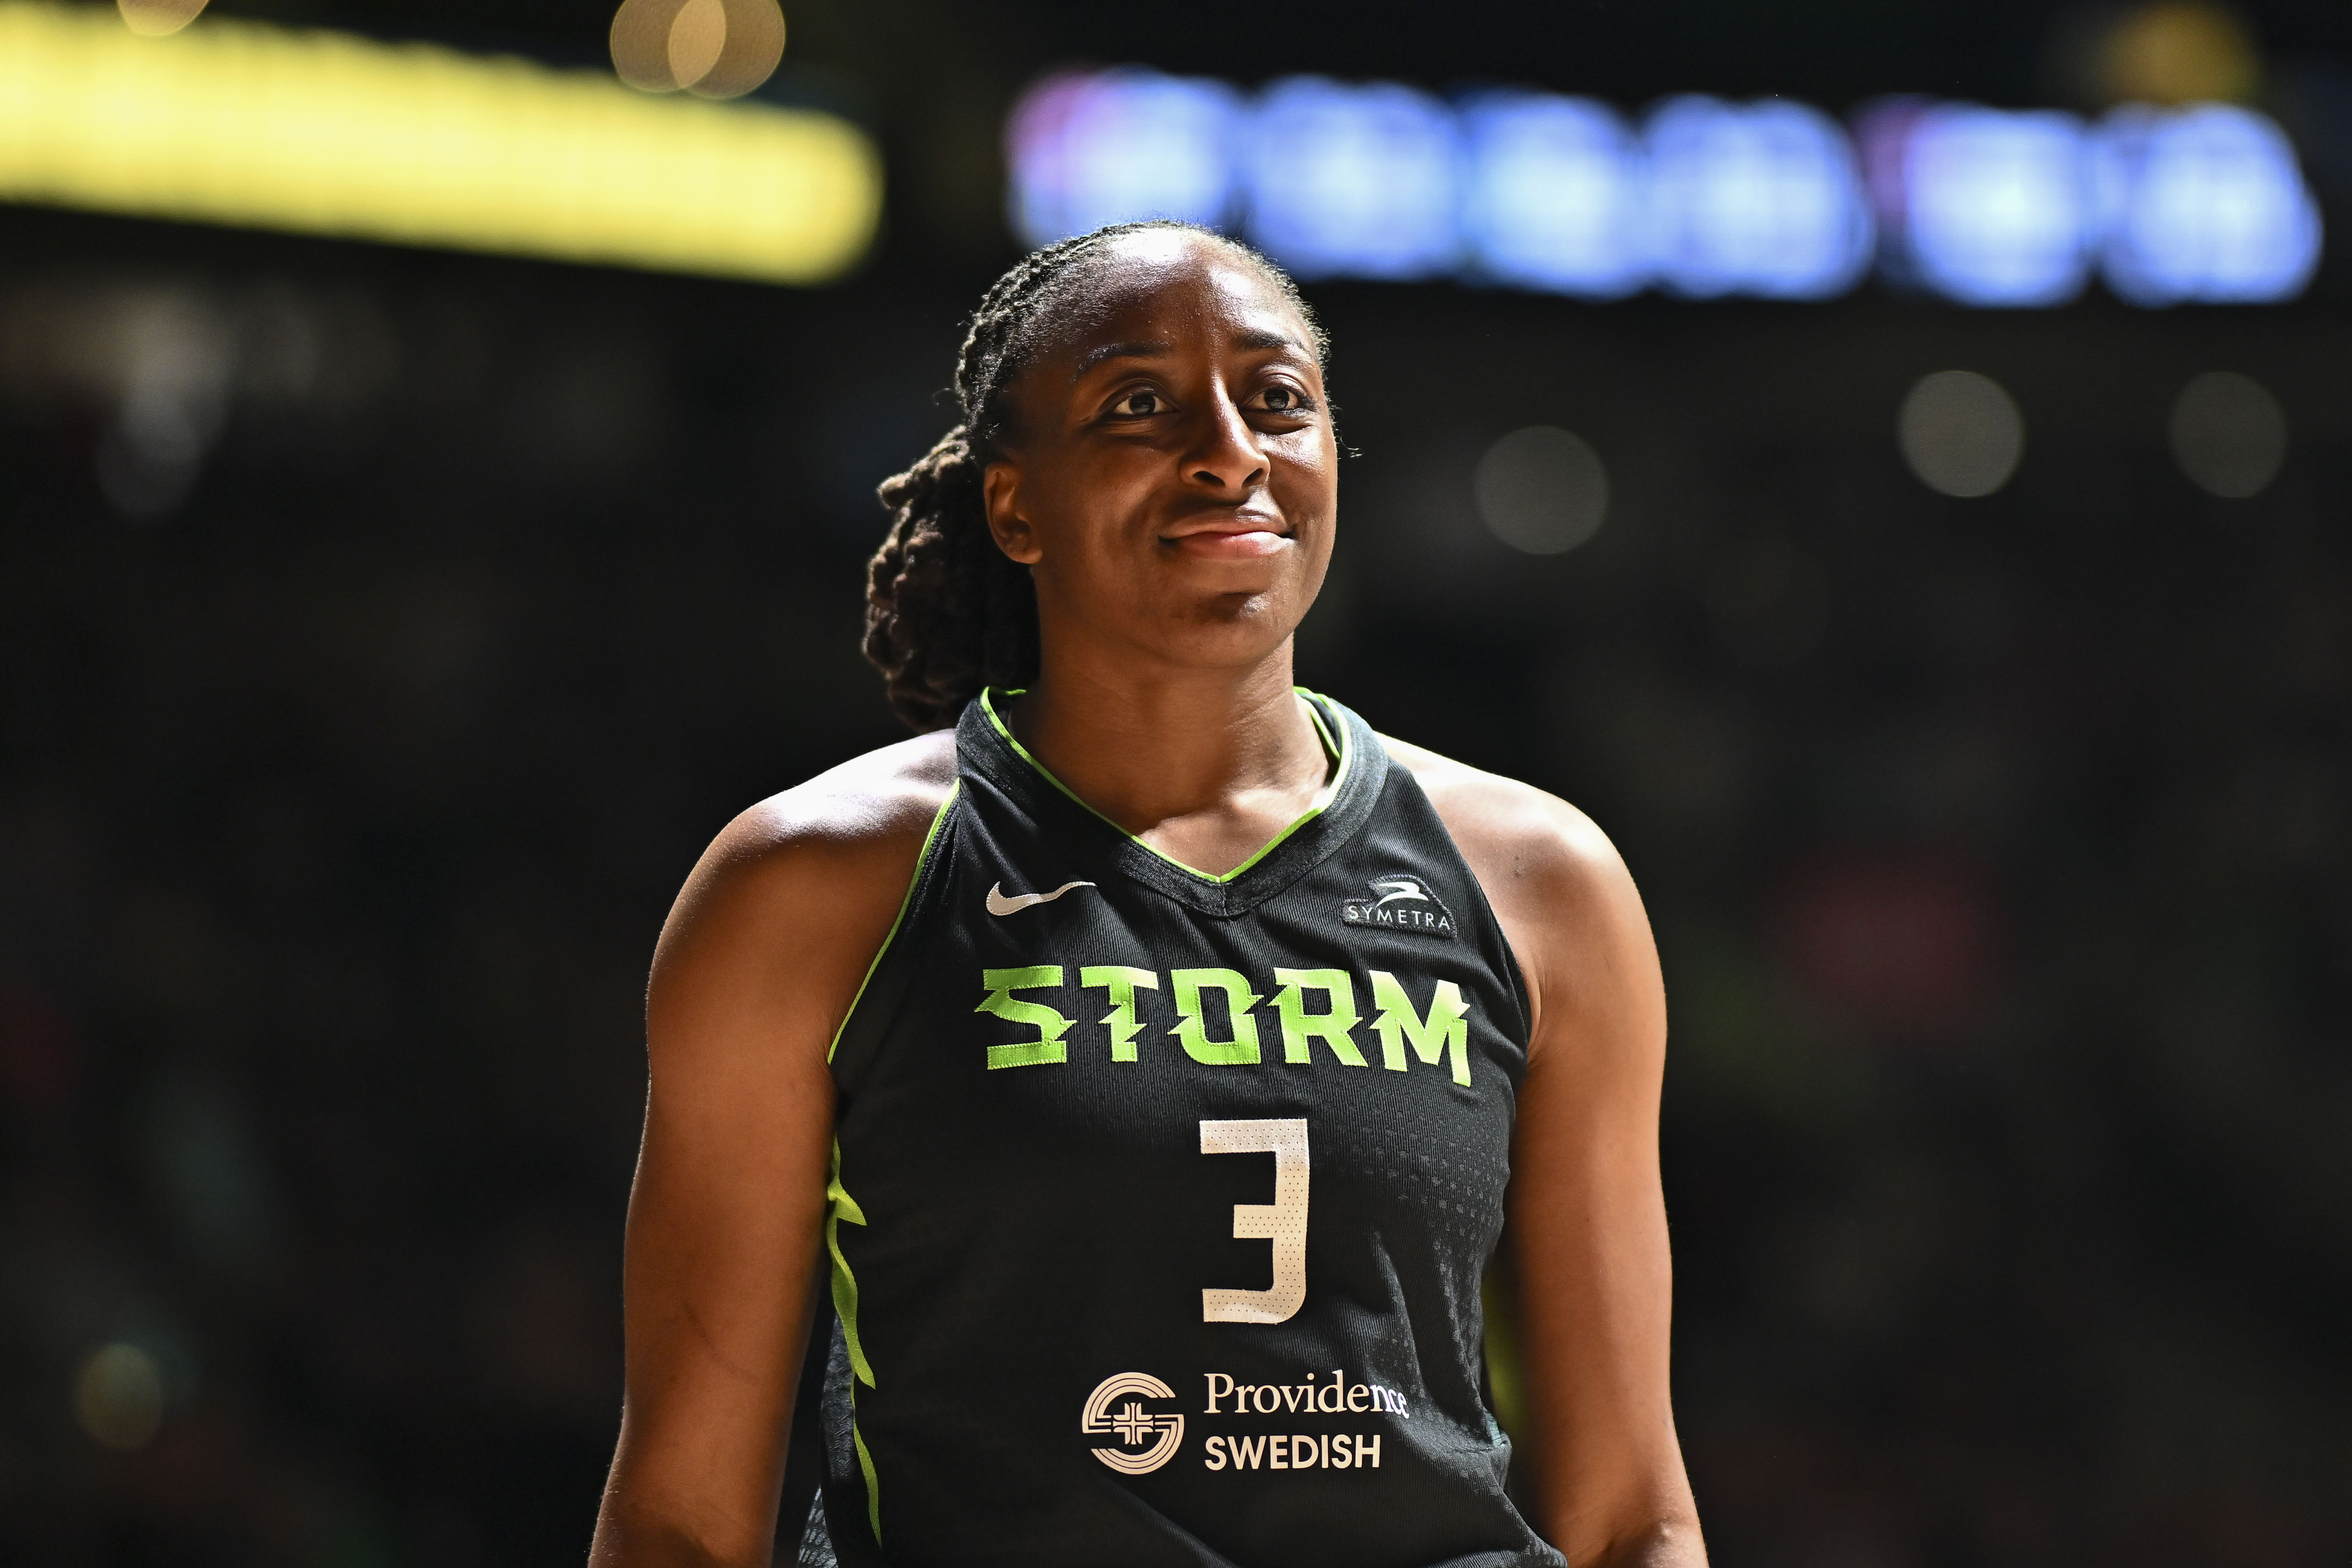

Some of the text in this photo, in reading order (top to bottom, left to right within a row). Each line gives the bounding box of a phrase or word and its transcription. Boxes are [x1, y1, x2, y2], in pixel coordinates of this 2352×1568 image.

[1348, 905, 1451, 931] SYMETRA
[974, 965, 1471, 1087] STORM
[1199, 1118, 1310, 1324] 3
[1204, 1369, 1410, 1419] Providence
[1205, 1434, 1381, 1471] SWEDISH
